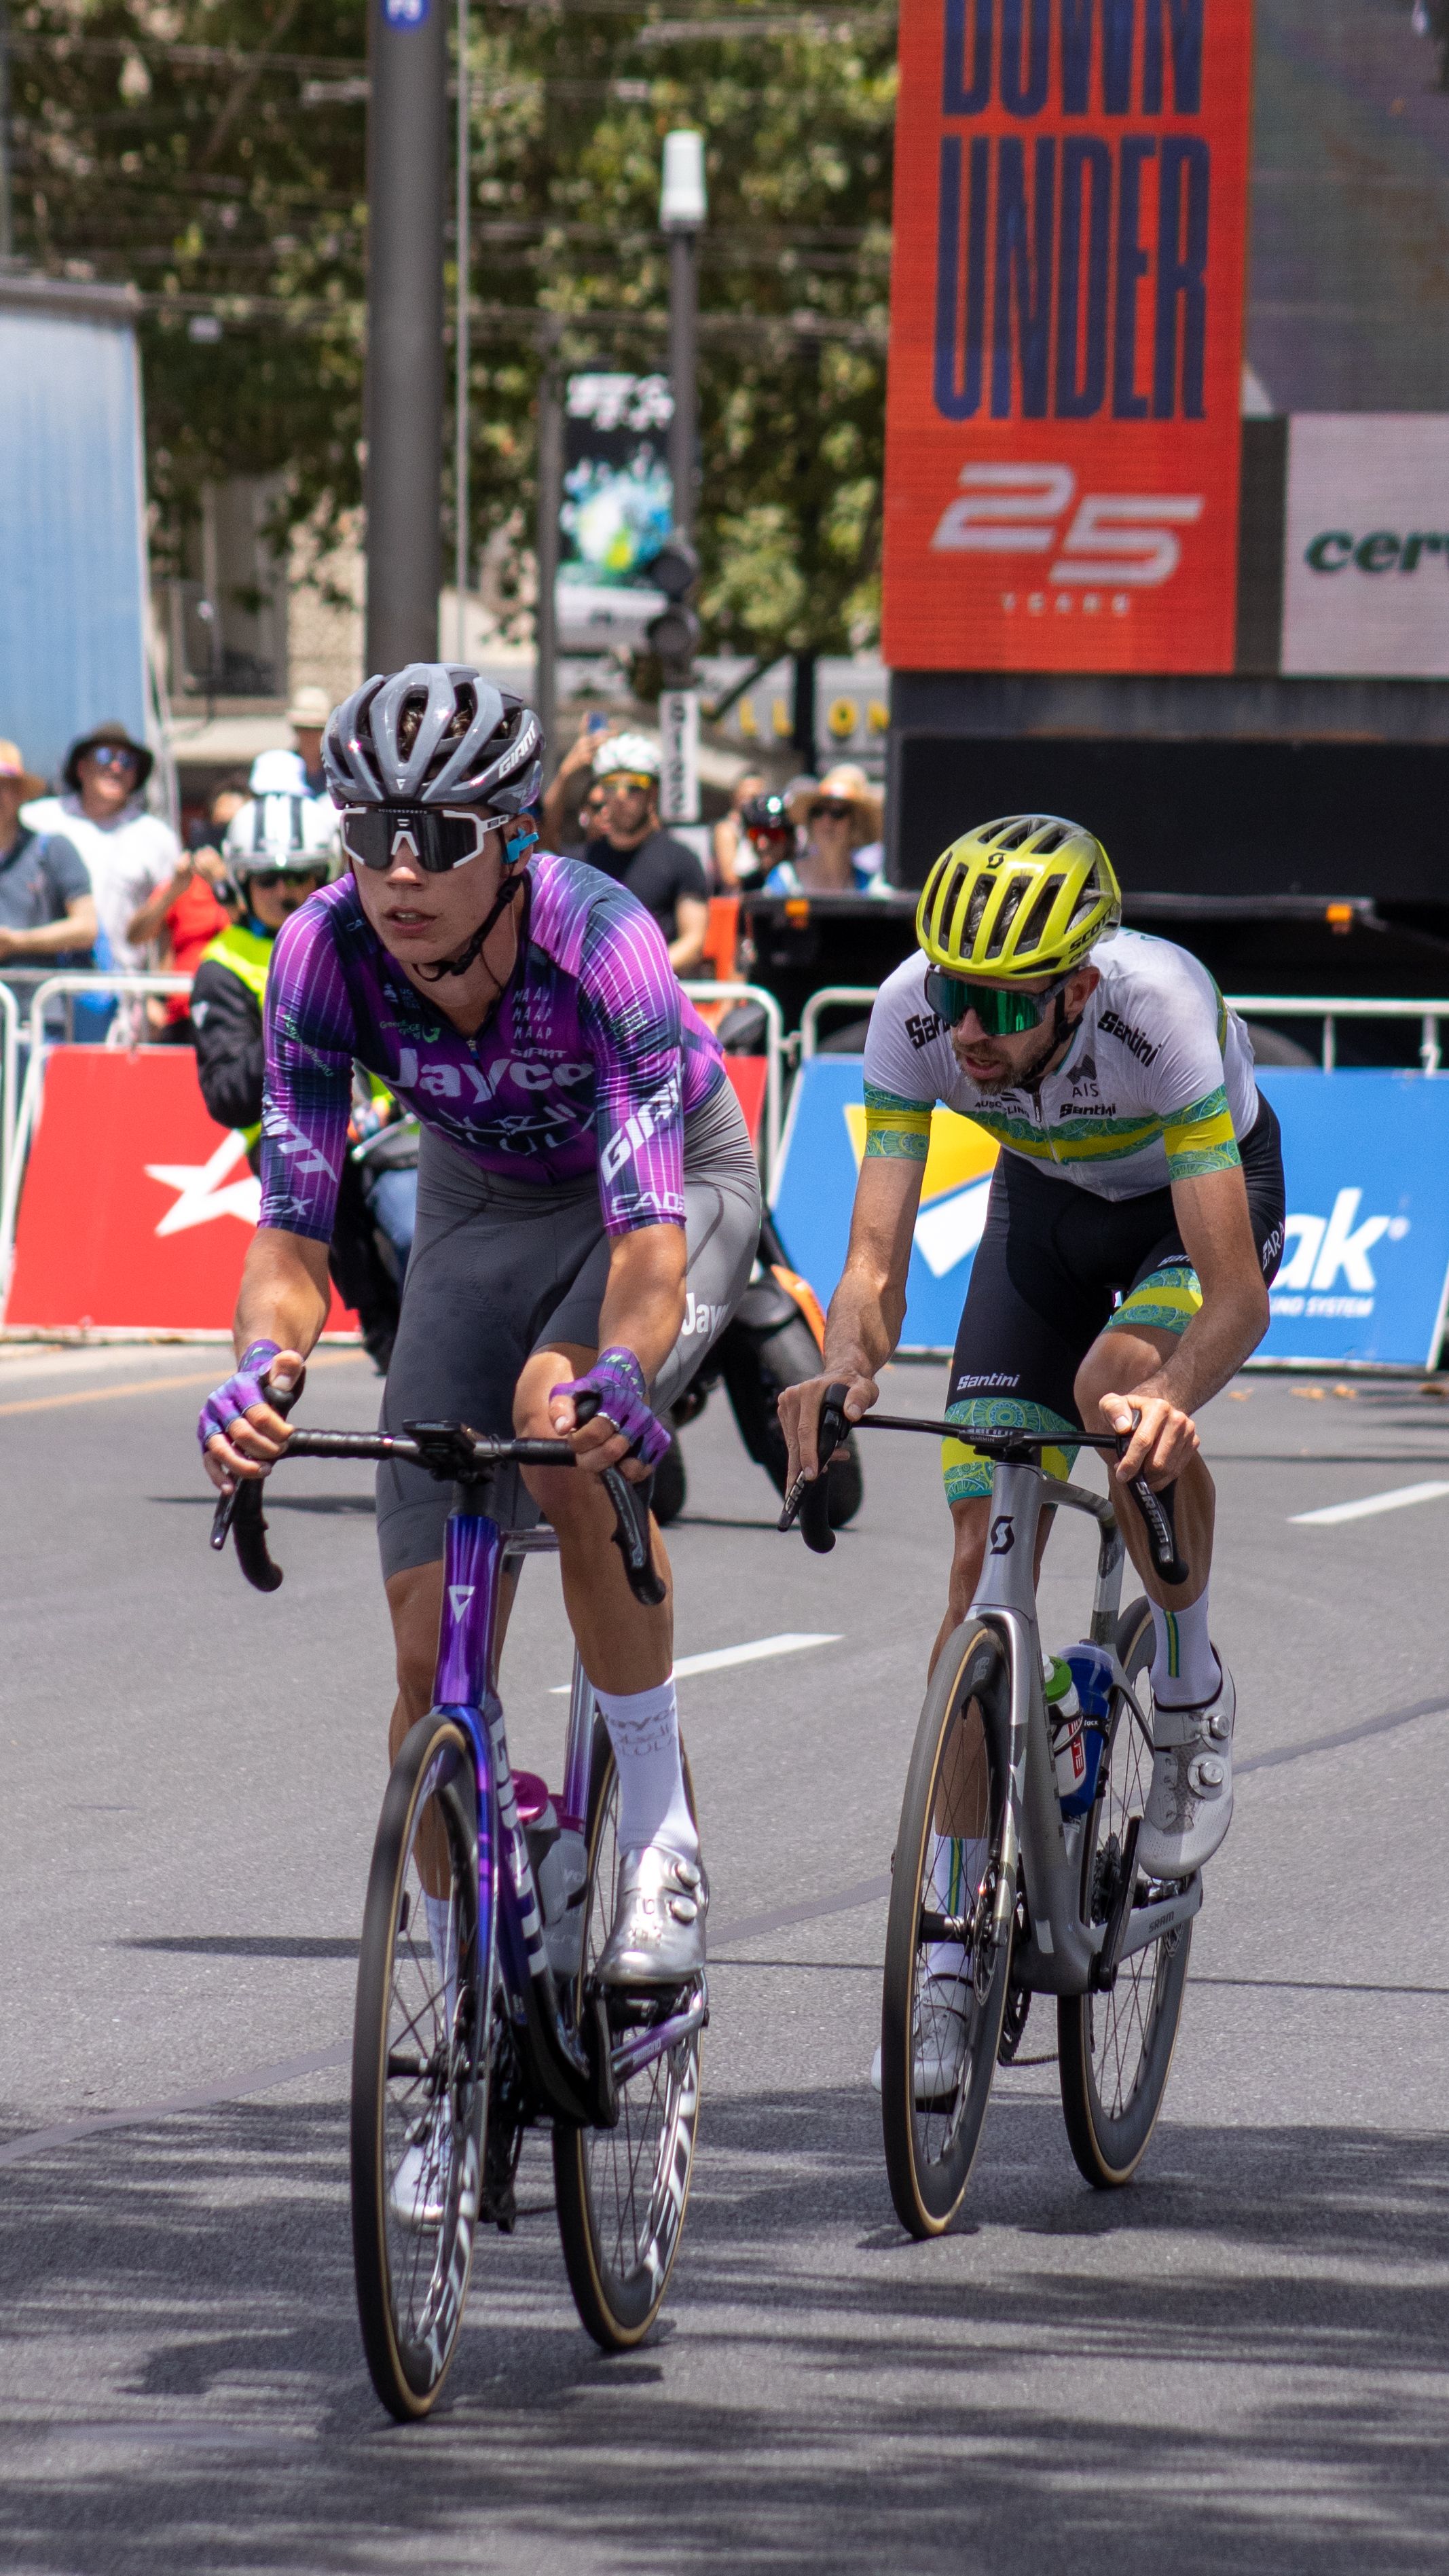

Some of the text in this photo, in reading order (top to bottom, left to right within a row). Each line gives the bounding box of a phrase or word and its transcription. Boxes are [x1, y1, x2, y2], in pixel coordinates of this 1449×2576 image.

[934, 134, 1209, 420] UNDER
[931, 462, 1205, 586] 25
[1304, 528, 1449, 575] cer
[498, 719, 538, 780] GIANT
[513, 1026, 552, 1040] MAAP
[1097, 1010, 1162, 1068] Santini
[375, 1047, 595, 1104] Jayco
[1072, 1083, 1099, 1098] AIS
[1059, 1103, 1116, 1119] Santini
[1267, 1187, 1391, 1291] ak
[956, 1372, 1021, 1392] Santini
[970, 1434, 995, 1443] GARMIN
[1148, 1910, 1175, 1933] SRAM
